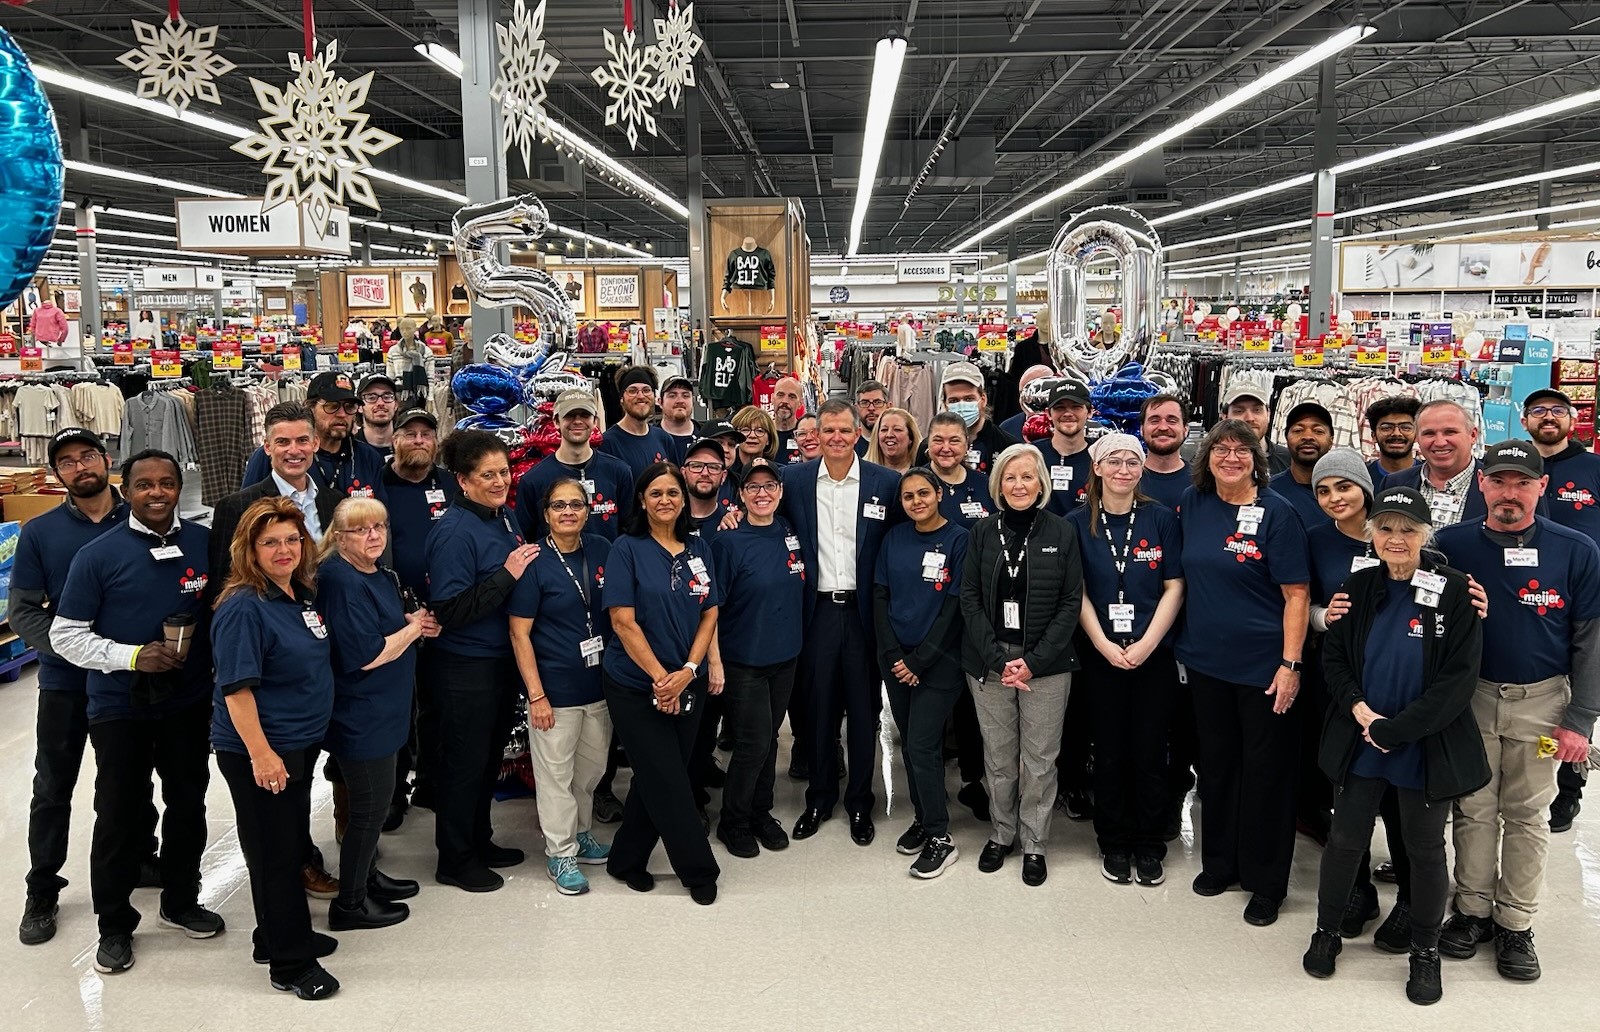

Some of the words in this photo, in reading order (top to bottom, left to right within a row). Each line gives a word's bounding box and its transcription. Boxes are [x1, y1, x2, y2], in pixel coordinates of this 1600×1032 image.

[208, 215, 271, 232] WOMEN
[736, 255, 760, 270] BAD
[737, 269, 759, 285] ELF
[903, 267, 945, 275] ACCESSORIES
[162, 274, 177, 282] MEN
[352, 277, 384, 287] EMPOWERED
[600, 277, 636, 286] CONFIDENCE
[353, 285, 372, 299] SUITS
[372, 286, 385, 301] YOU
[600, 284, 635, 299] BEYOND
[142, 294, 153, 305] DO
[603, 295, 633, 304] MEASURE
[1512, 295, 1533, 304] CARE
[1545, 295, 1576, 303] STYLING
[1528, 346, 1548, 359] Venus
[715, 356, 737, 372] BAD
[714, 372, 734, 388] ELF
[1056, 383, 1077, 392] meijer
[1485, 419, 1506, 432] Venus
[56, 428, 82, 442] meijer
[1498, 447, 1529, 459] meijer
[351, 487, 374, 499] meijer
[1383, 493, 1413, 505] meijer
[1561, 490, 1592, 502] meijer
[593, 501, 616, 513] meijer
[1227, 540, 1259, 555] meijer
[1137, 547, 1163, 561] meije
[1523, 590, 1561, 607] meijer
